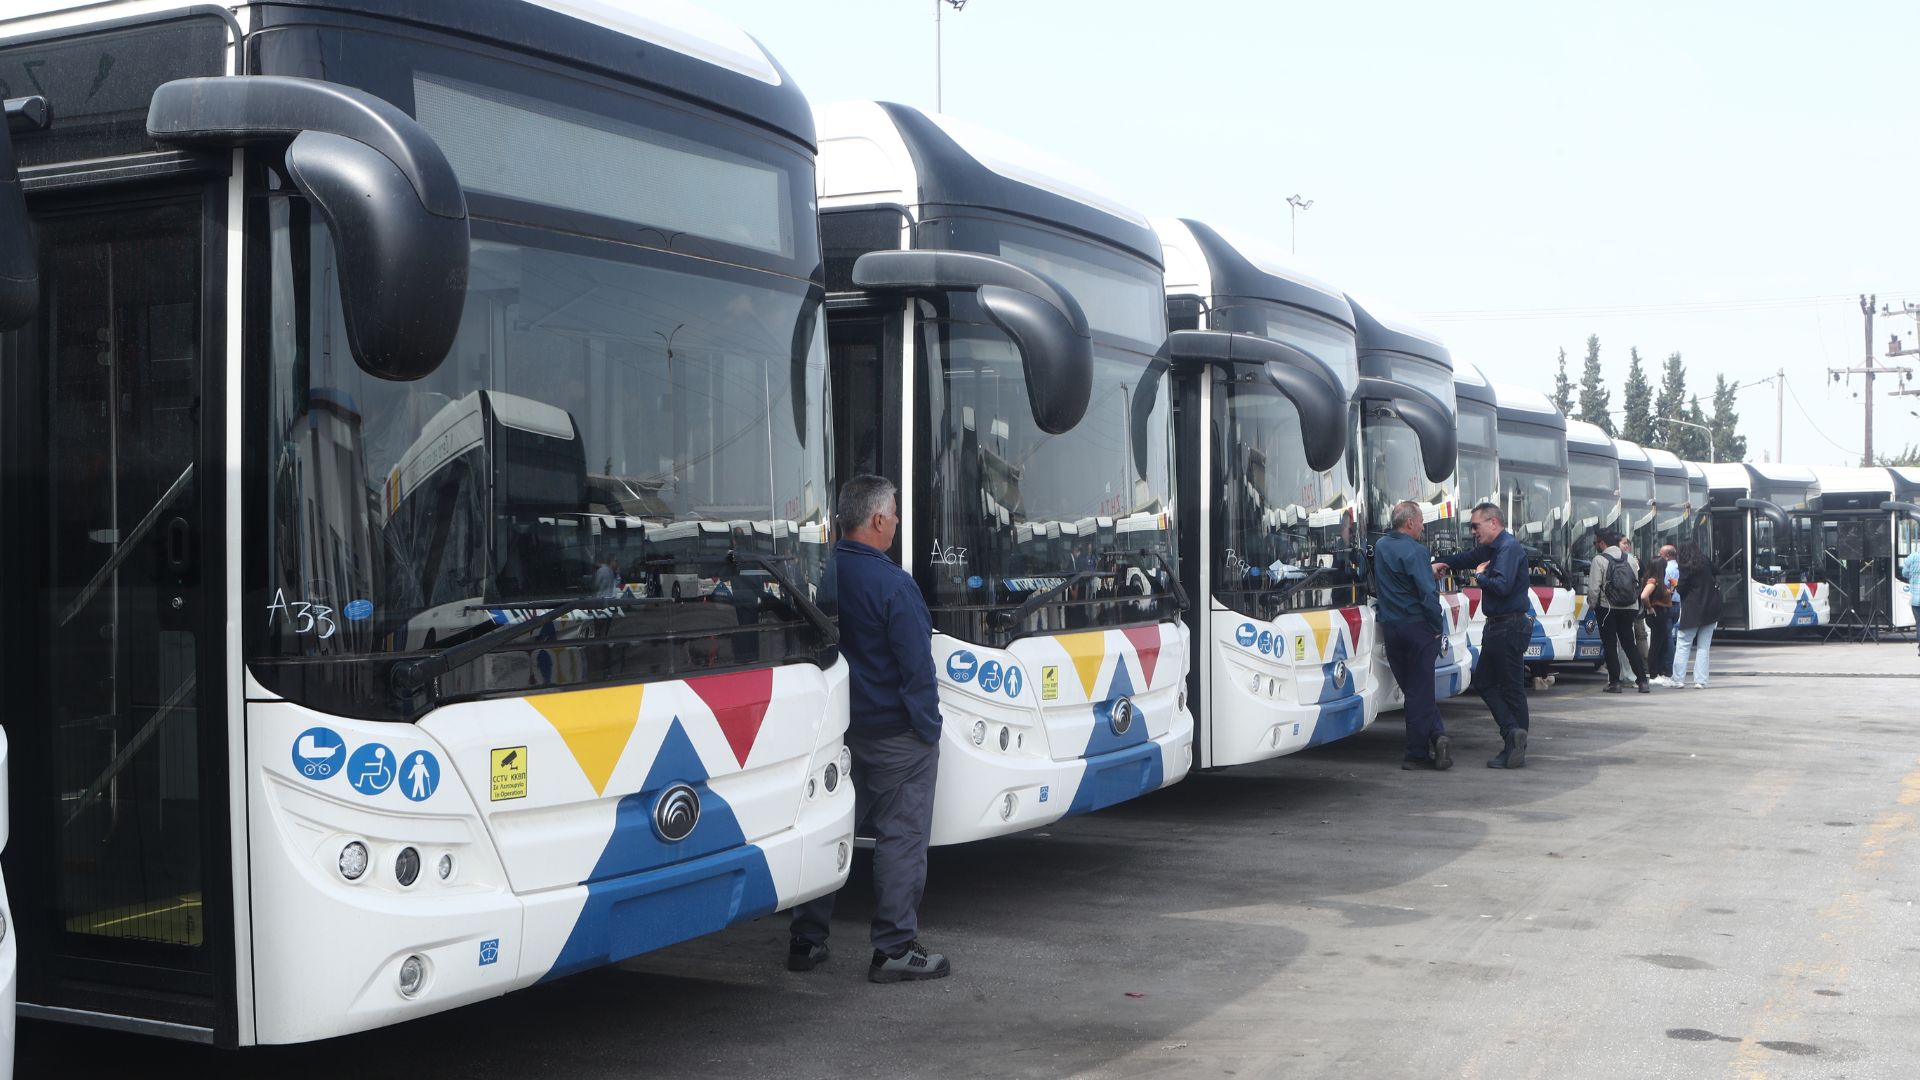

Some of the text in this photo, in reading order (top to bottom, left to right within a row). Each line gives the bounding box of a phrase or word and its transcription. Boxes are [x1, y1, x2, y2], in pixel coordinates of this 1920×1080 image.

[930, 538, 968, 567] A67
[266, 587, 336, 640] A33
[493, 775, 508, 783] CCTV
[501, 790, 523, 798] Operation
